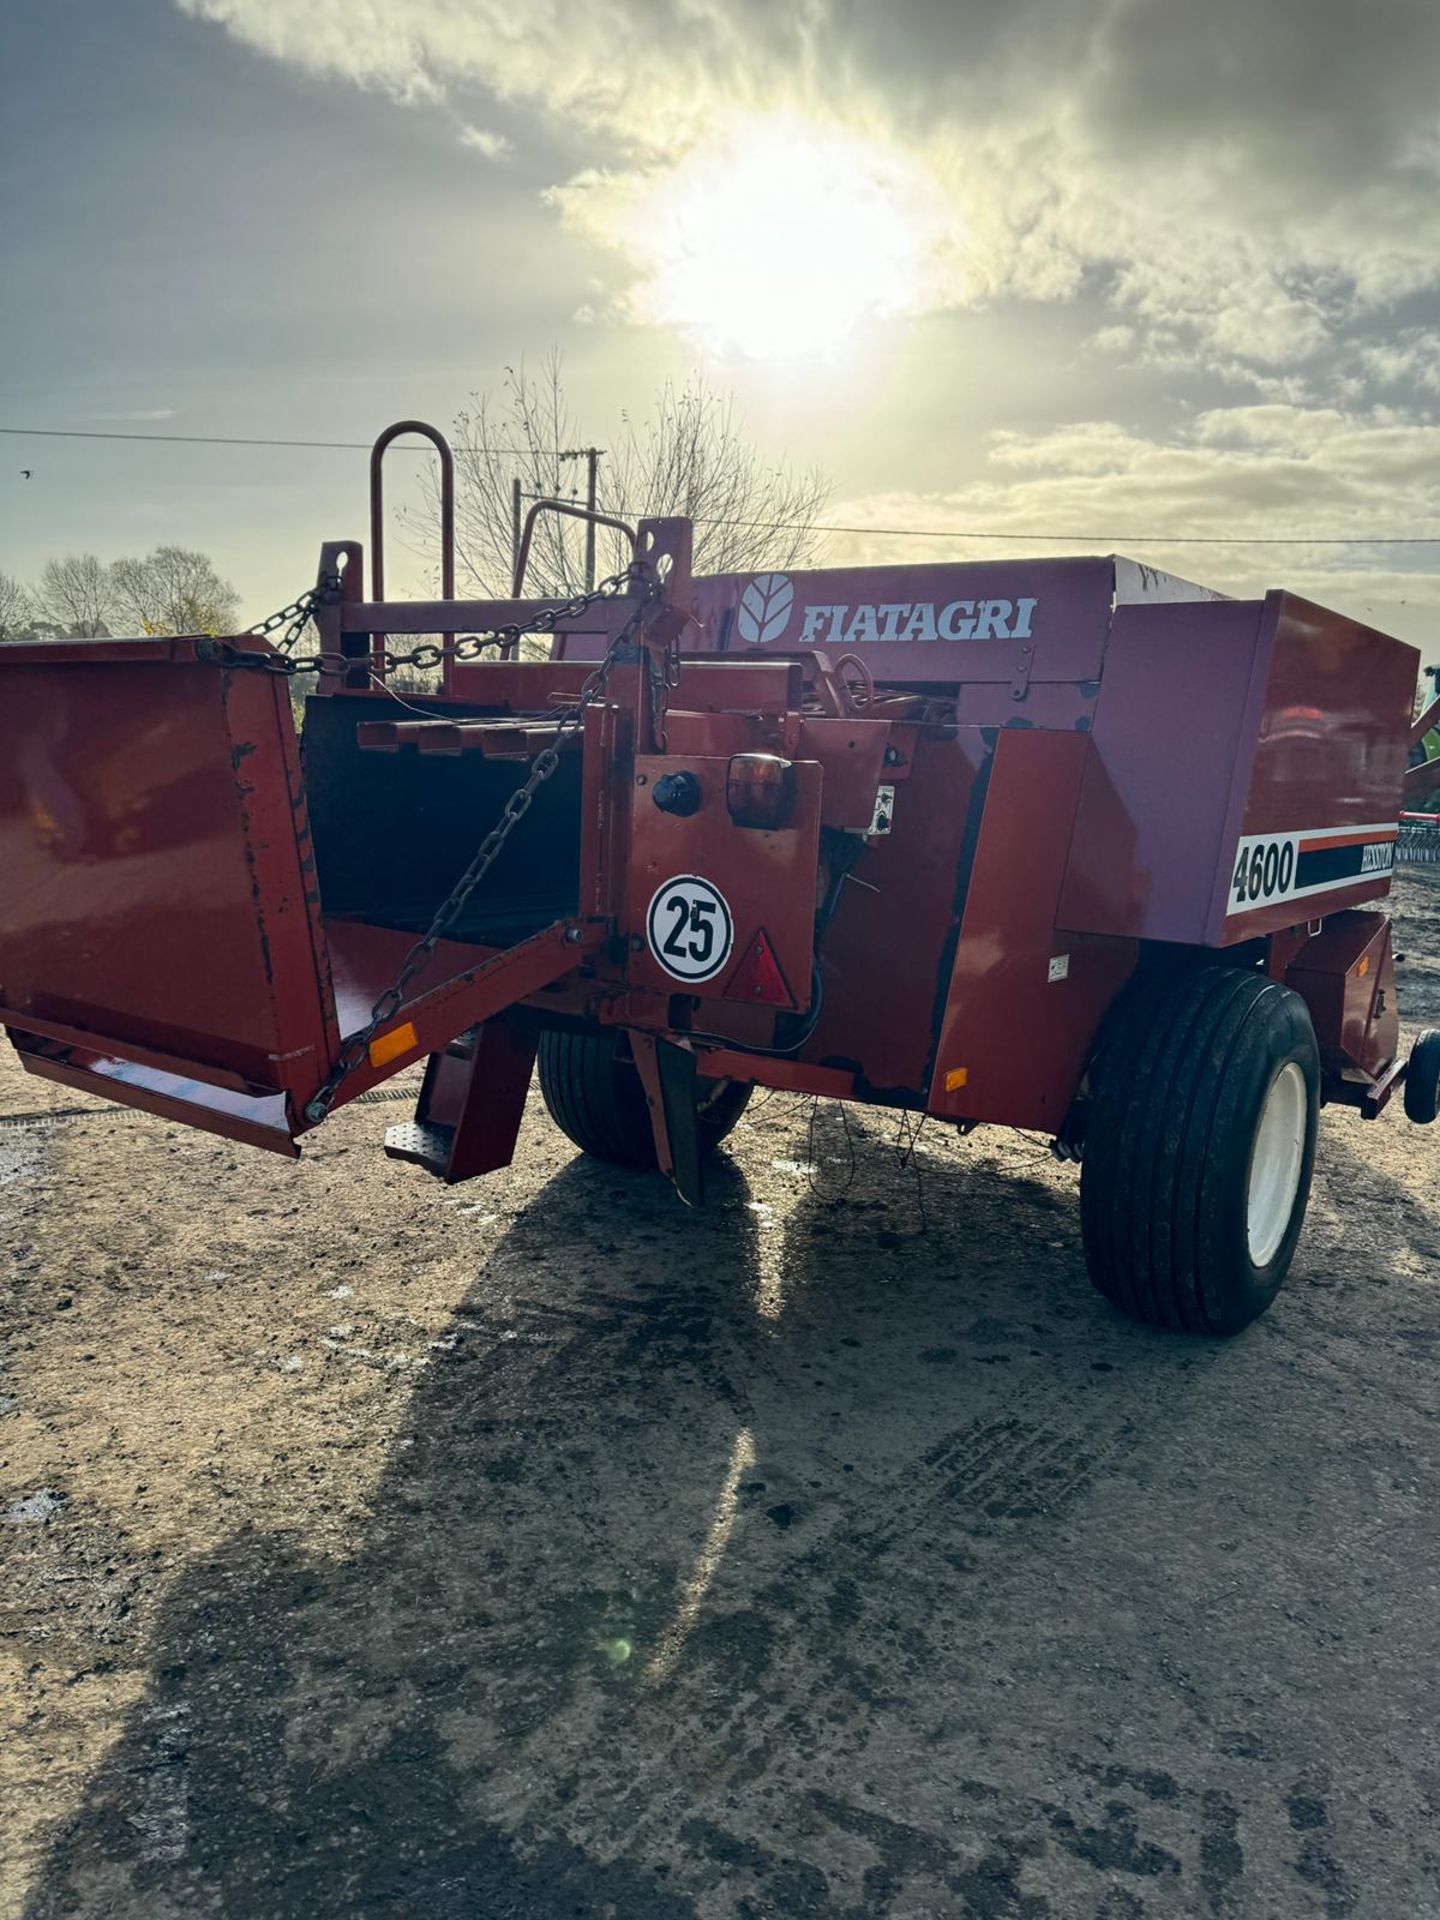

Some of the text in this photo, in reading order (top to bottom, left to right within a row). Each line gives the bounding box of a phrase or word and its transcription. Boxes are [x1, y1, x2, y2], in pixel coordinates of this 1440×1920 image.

[800, 598, 1038, 643] FIATAGRI
[1233, 840, 1294, 902] 4600
[663, 895, 717, 962] 25
